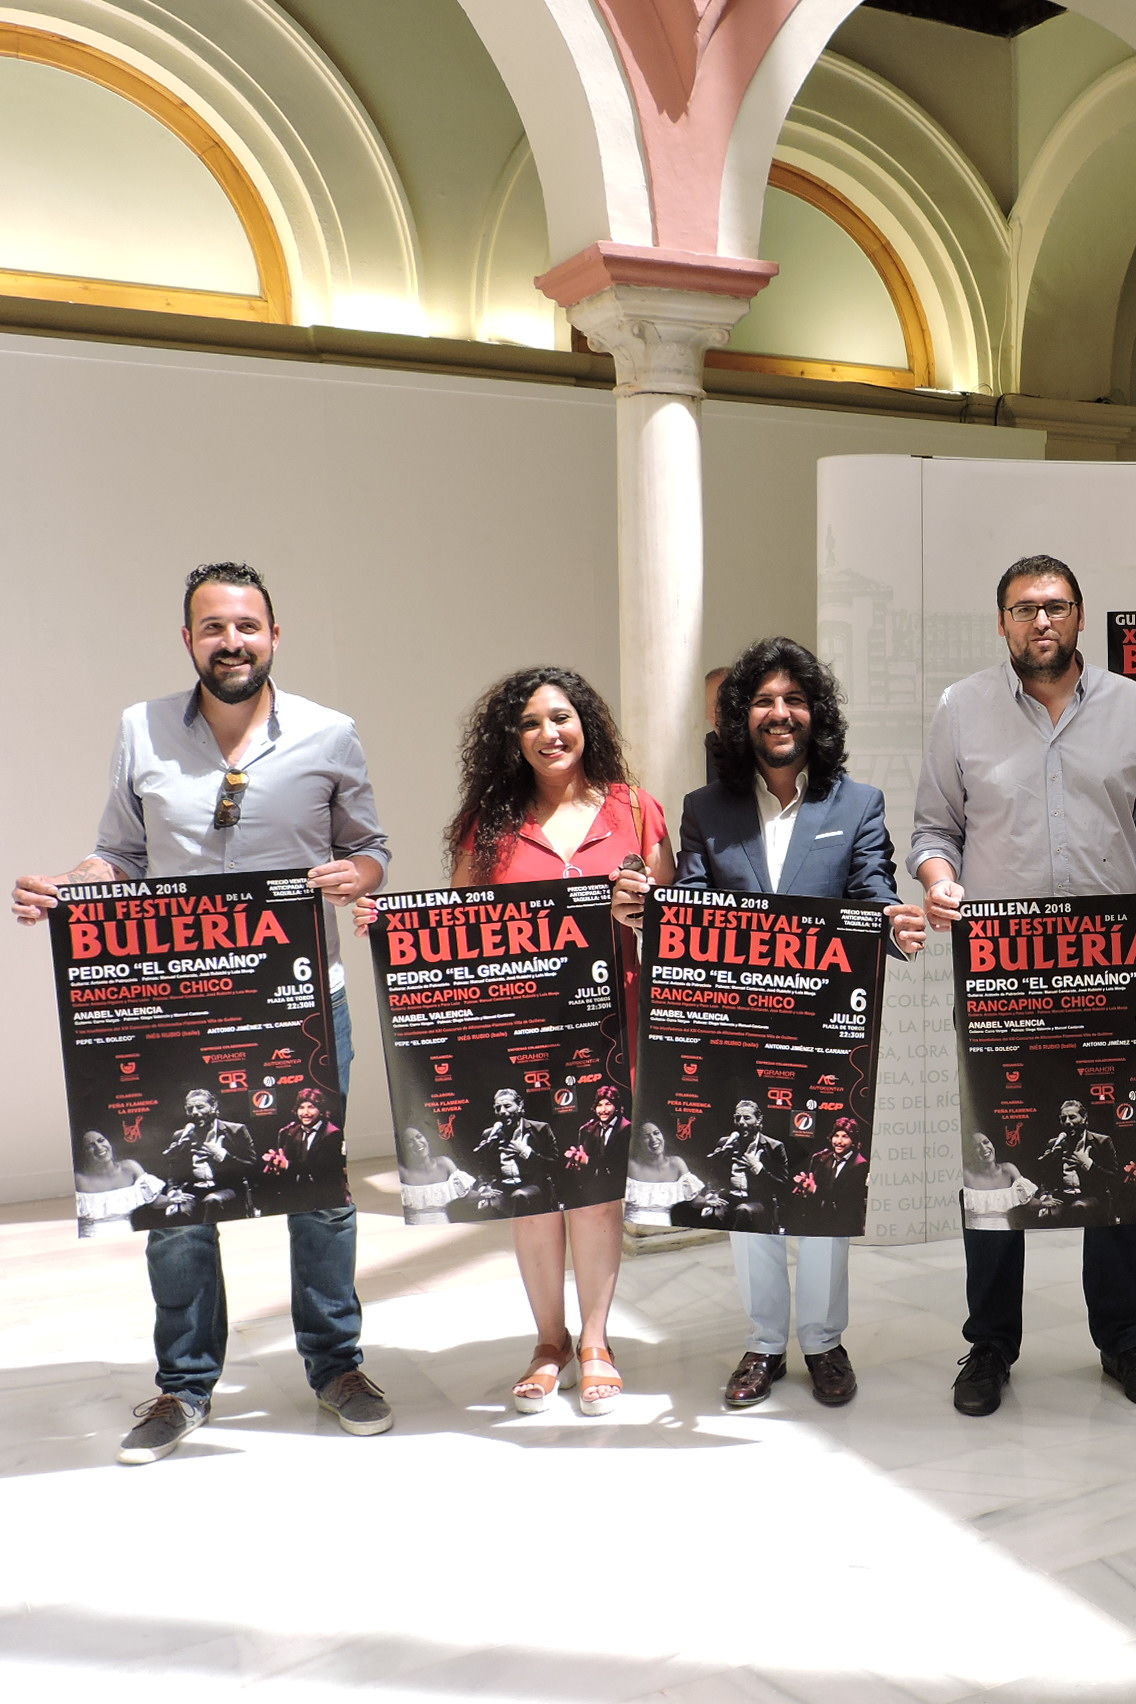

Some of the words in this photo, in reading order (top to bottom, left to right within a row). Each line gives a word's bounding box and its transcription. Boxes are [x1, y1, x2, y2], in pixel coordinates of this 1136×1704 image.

[55, 882, 151, 904] GUILLENA
[155, 882, 187, 894] 2018
[375, 890, 462, 913] GUILLENA
[465, 890, 494, 902] 2018
[653, 887, 736, 906] GUILLENA
[740, 897, 768, 909] 2018
[67, 903, 104, 922] XII
[115, 894, 228, 919] FESTIVAL
[225, 893, 238, 901] DE
[240, 892, 252, 900] LA
[385, 911, 419, 930] XII
[428, 900, 532, 926] FESTIVAL
[959, 901, 1040, 919] GUILLENA
[1044, 902, 1071, 913] 2018
[660, 905, 692, 923] XII
[702, 908, 803, 932] FESTIVAL
[801, 915, 811, 923] DE
[968, 919, 999, 937] XII
[1009, 914, 1107, 935] FESTIVAL
[68, 903, 289, 959] BULERÍA
[387, 909, 588, 965] BULERÍA
[658, 923, 851, 972] BULERÍA
[67, 963, 129, 980] PEDRO
[293, 957, 311, 980] 6
[386, 969, 442, 985] PEDRO
[591, 960, 608, 983] 6
[652, 964, 705, 980] PEDRO
[70, 983, 171, 1002] RANCAPINO
[180, 977, 232, 993] CHICO
[274, 983, 313, 996] JULIO
[574, 985, 610, 998] JULIO
[966, 977, 1018, 991] PEDRO
[388, 987, 480, 1006] RANCAPINO
[488, 981, 536, 996] CHICO
[651, 986, 739, 1004] RANCAPINO
[747, 994, 794, 1008] CHICO
[850, 987, 866, 1011] 6
[967, 997, 1053, 1012] RANCAPINO
[1060, 994, 1106, 1008] CHICO
[73, 1010, 113, 1019] ANABEL
[114, 1005, 162, 1016] VALENCIA
[391, 1013, 428, 1023] ANABEL
[428, 1008, 473, 1020] VALENCIA
[650, 1007, 685, 1017] ANABEL
[686, 1010, 728, 1021] VALENCIA
[829, 1012, 865, 1024] JULIO
[899, 1020, 918, 1033] LA
[968, 1020, 1002, 1028] ANABEL
[1003, 1018, 1045, 1027] VALENCIA
[908, 1044, 948, 1058] LORA
[920, 1070, 949, 1083] LOS
[902, 1096, 930, 1109] DEL
[888, 1148, 916, 1160] DEL
[871, 1198, 891, 1211] DE
[876, 1224, 896, 1236] DE
